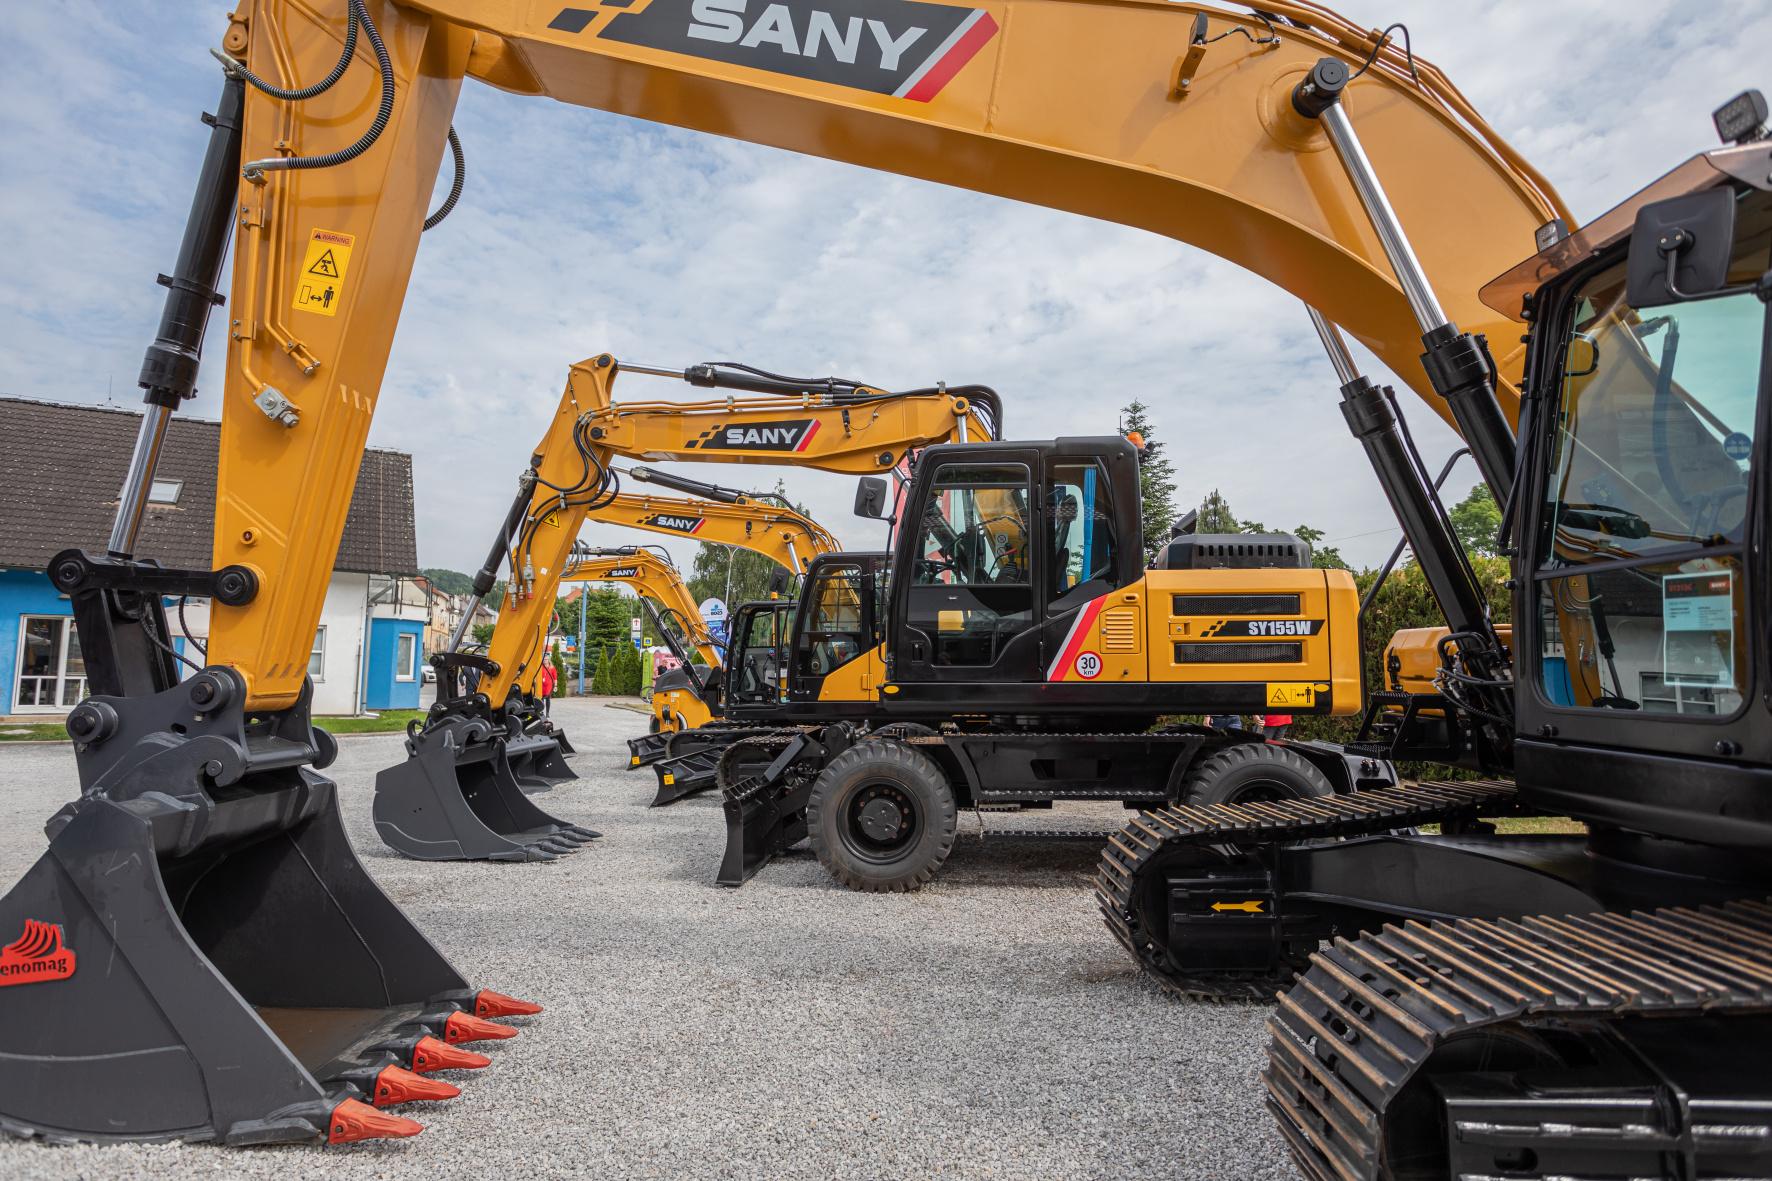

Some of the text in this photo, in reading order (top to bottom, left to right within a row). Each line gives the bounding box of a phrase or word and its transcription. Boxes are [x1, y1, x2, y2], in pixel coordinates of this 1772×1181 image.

[687, 0, 928, 71] SANY
[322, 234, 350, 244] WARNING
[726, 428, 798, 444] SANY
[657, 516, 695, 529] SANY
[1248, 621, 1311, 635] SY155W
[1081, 657, 1096, 669] 30
